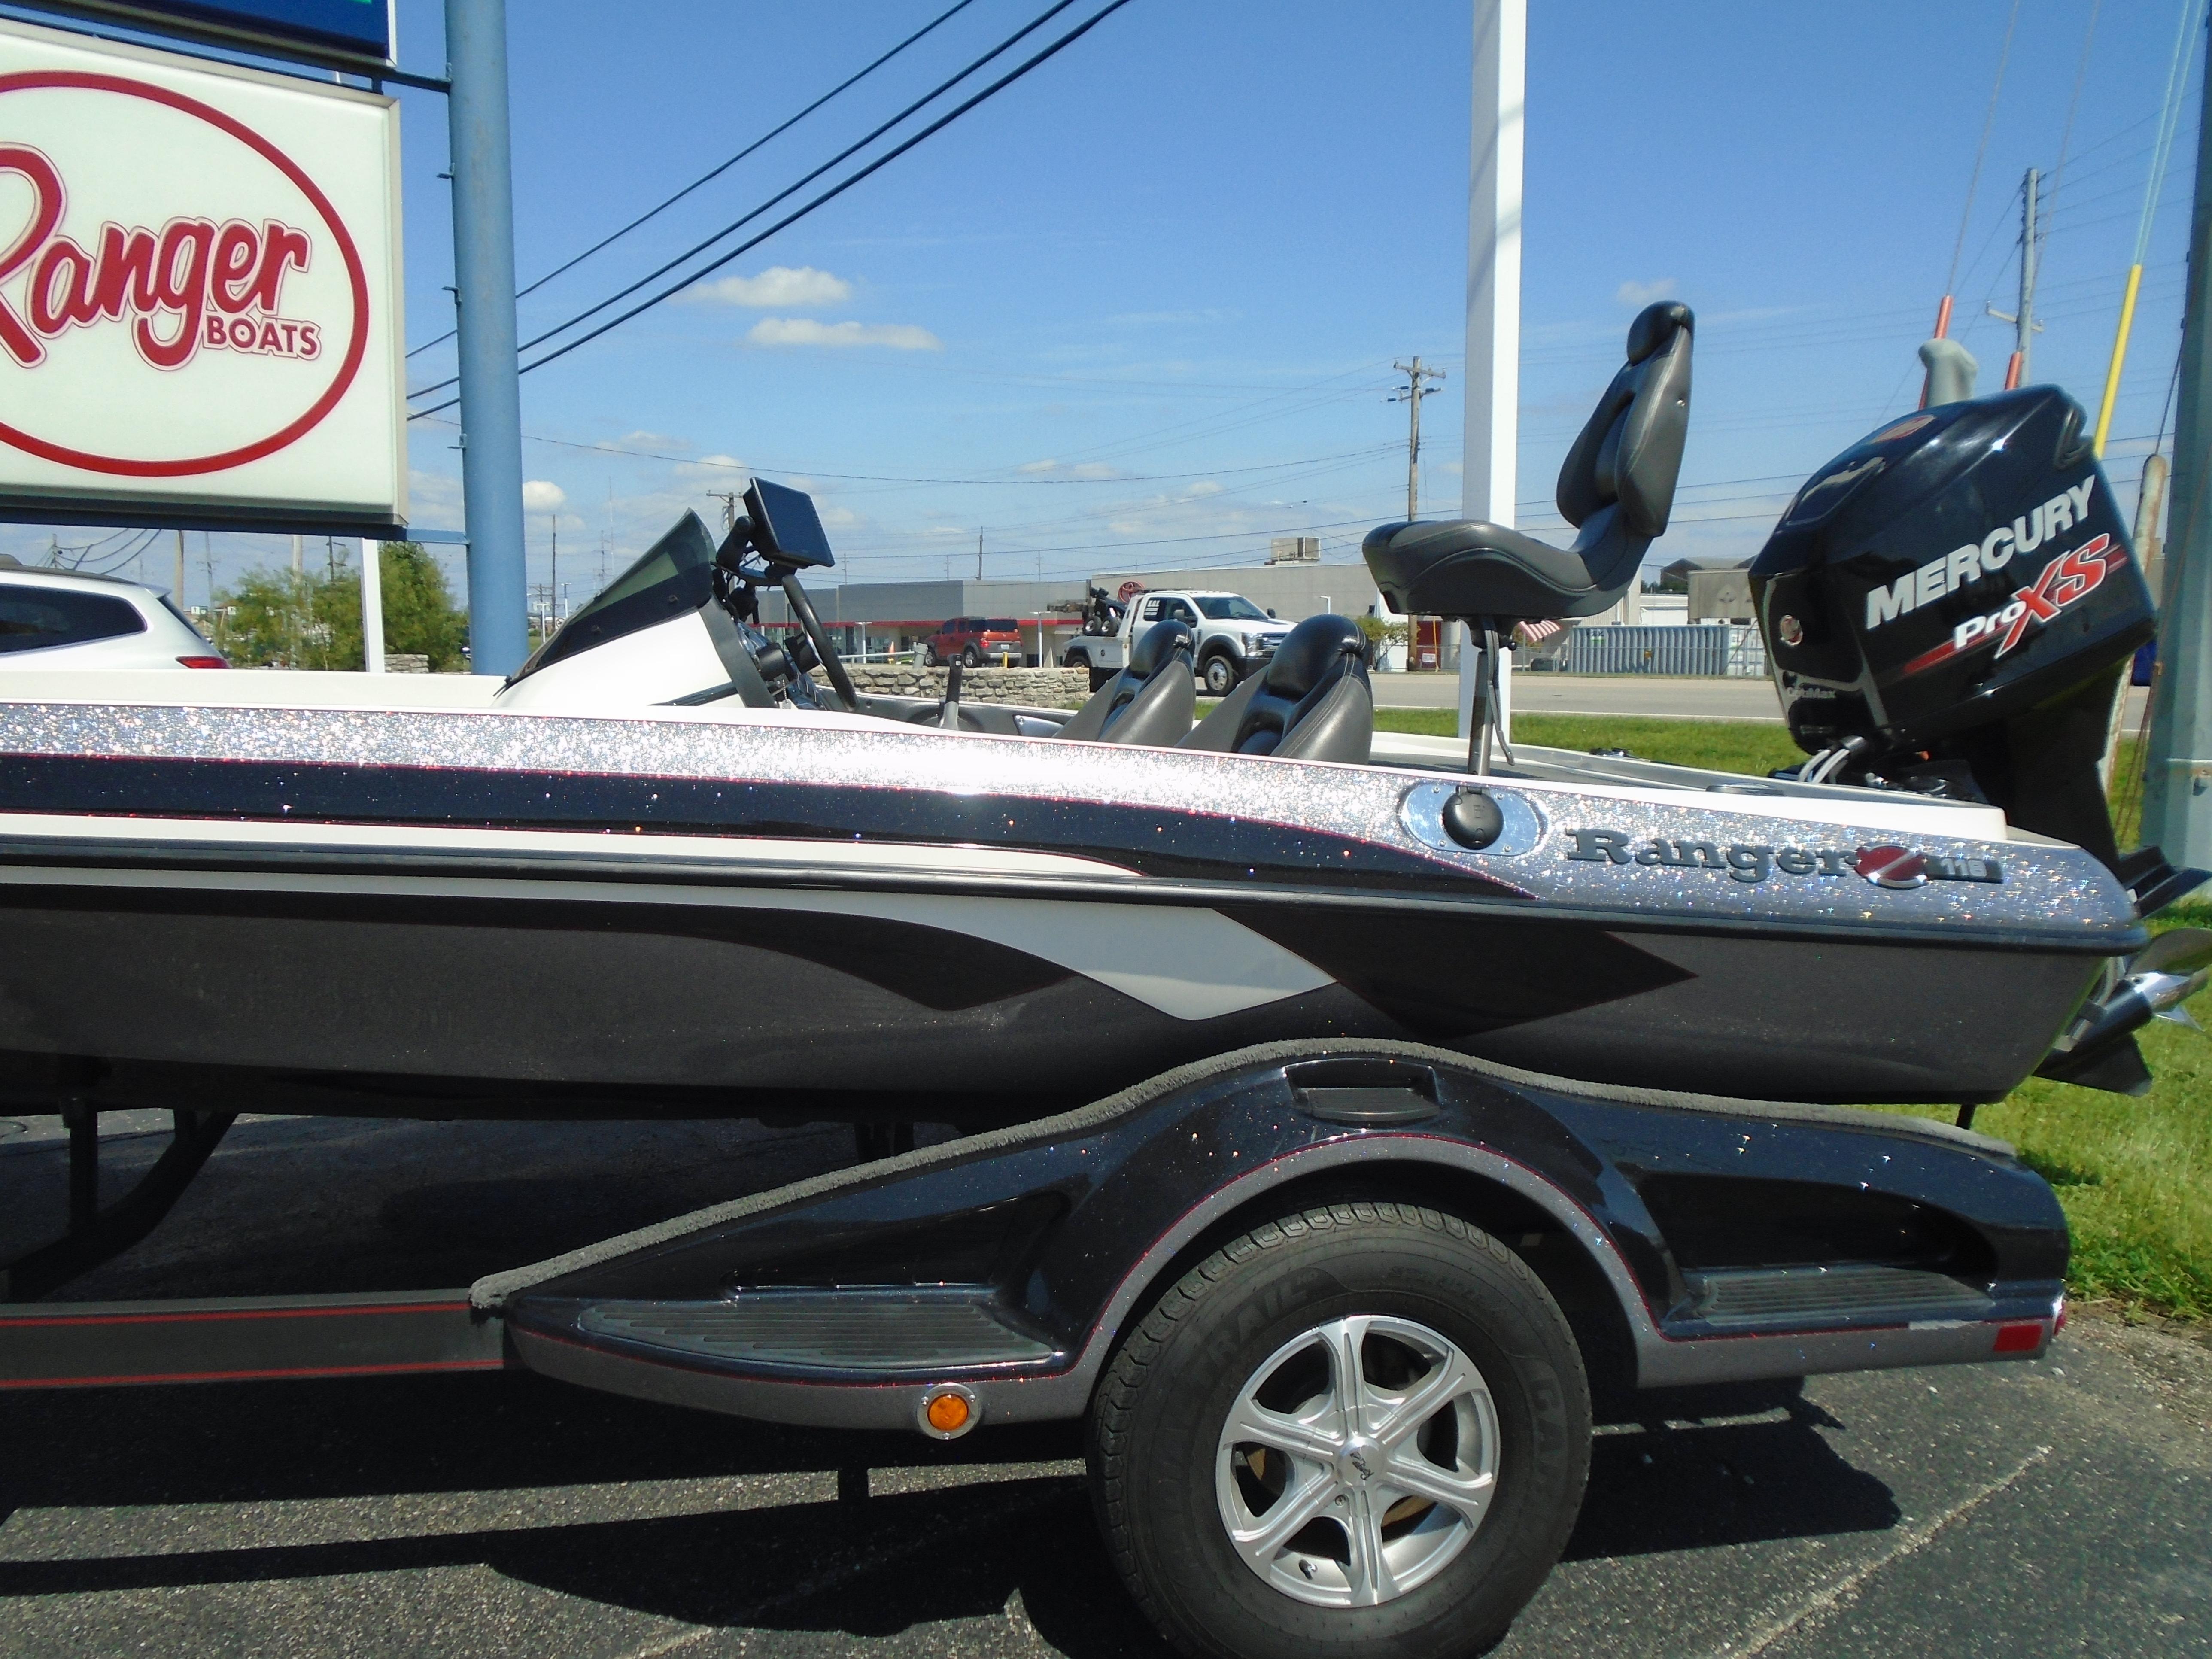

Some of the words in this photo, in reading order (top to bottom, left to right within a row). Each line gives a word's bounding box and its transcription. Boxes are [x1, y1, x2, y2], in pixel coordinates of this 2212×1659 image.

[205, 315, 319, 357] BOATS
[1866, 474, 2095, 629] MERCURY
[1565, 828, 1857, 883] Ranger
